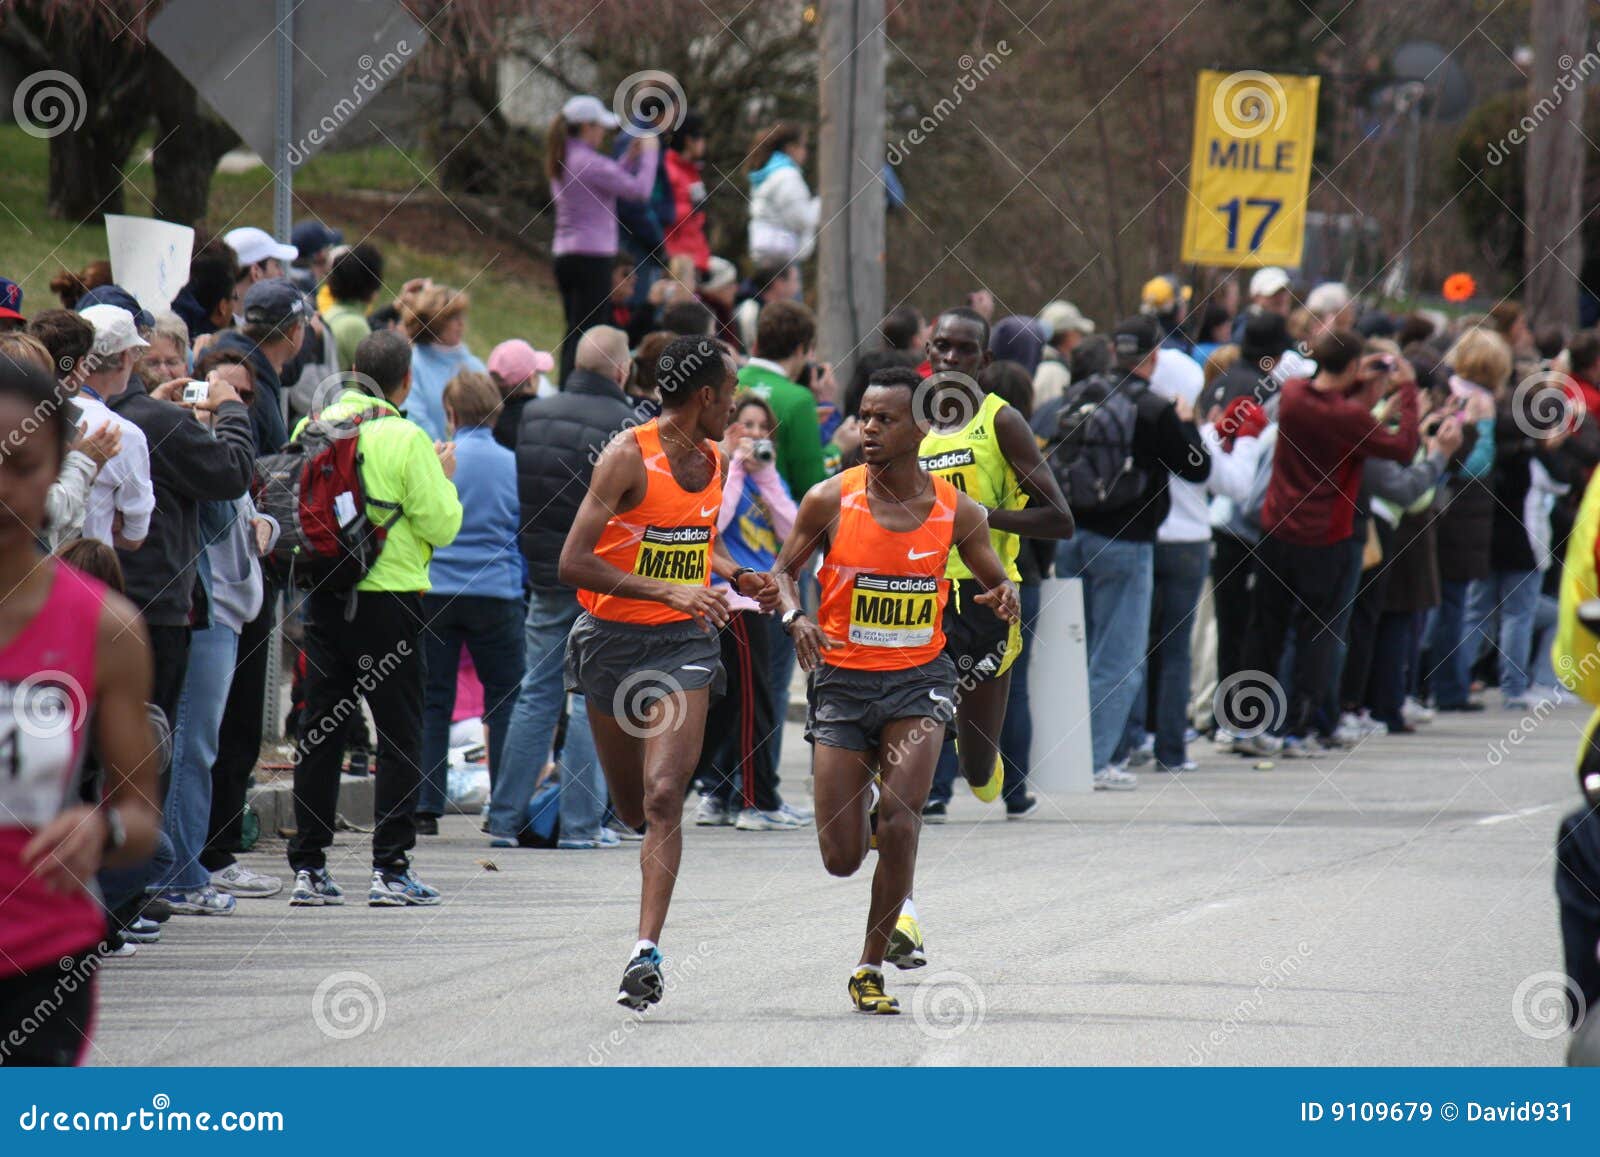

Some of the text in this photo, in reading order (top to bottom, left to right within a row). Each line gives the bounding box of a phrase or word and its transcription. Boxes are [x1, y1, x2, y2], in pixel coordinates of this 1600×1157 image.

[1208, 139, 1296, 173] MILE
[1217, 196, 1283, 252] 17
[927, 449, 972, 469] adidas
[673, 528, 709, 541] adidas
[637, 547, 705, 580] MERGA
[889, 579, 936, 591] adidas
[855, 594, 933, 626] MOLLA
